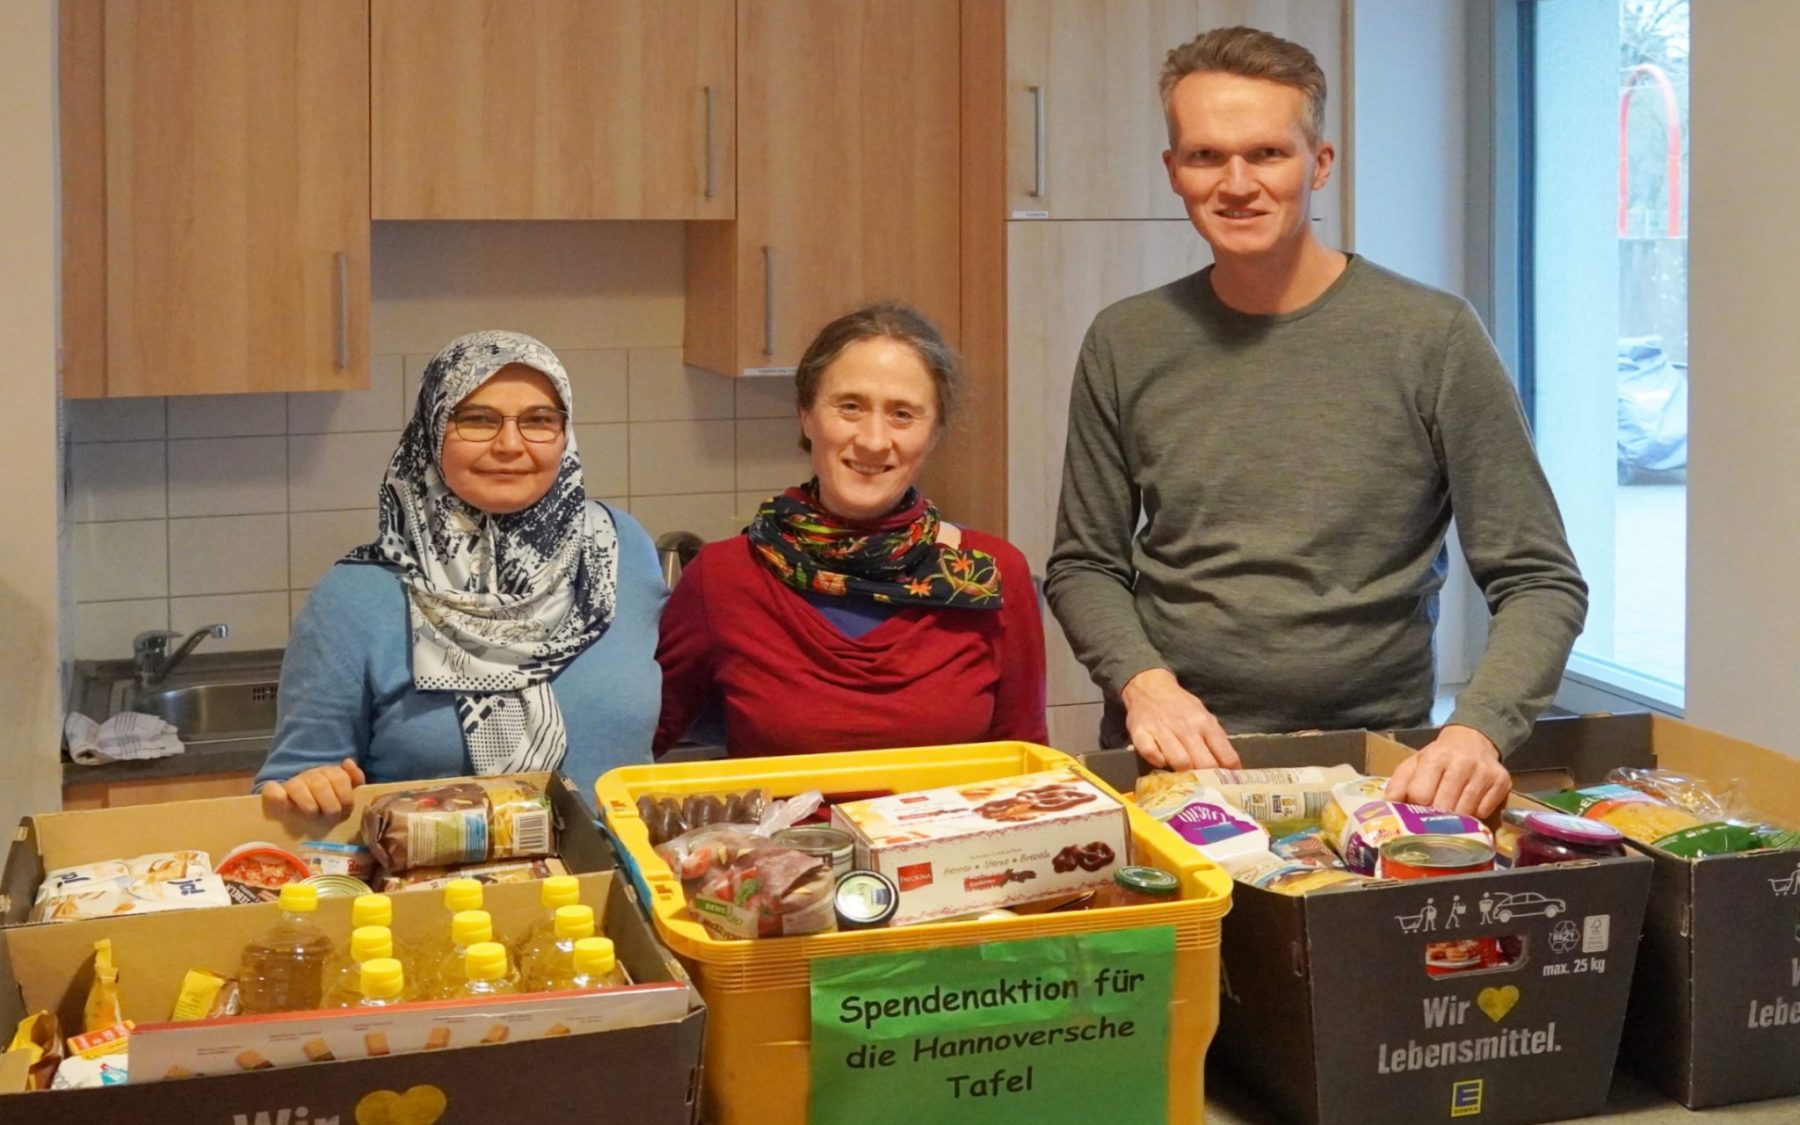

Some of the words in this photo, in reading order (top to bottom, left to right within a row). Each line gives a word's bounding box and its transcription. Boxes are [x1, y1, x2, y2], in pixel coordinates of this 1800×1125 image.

[1543, 963, 1570, 977] max.
[1573, 959, 1588, 974] 25
[1590, 957, 1606, 974] kg
[839, 978, 1079, 1029] Spendenaktion
[1094, 968, 1145, 997] für
[1423, 995, 1470, 1029] Wir
[846, 1045, 896, 1069] die
[913, 1016, 1136, 1062] Hannoversche
[1378, 1022, 1562, 1074] Lebensmittel.
[947, 1066, 1033, 1099] Tafel
